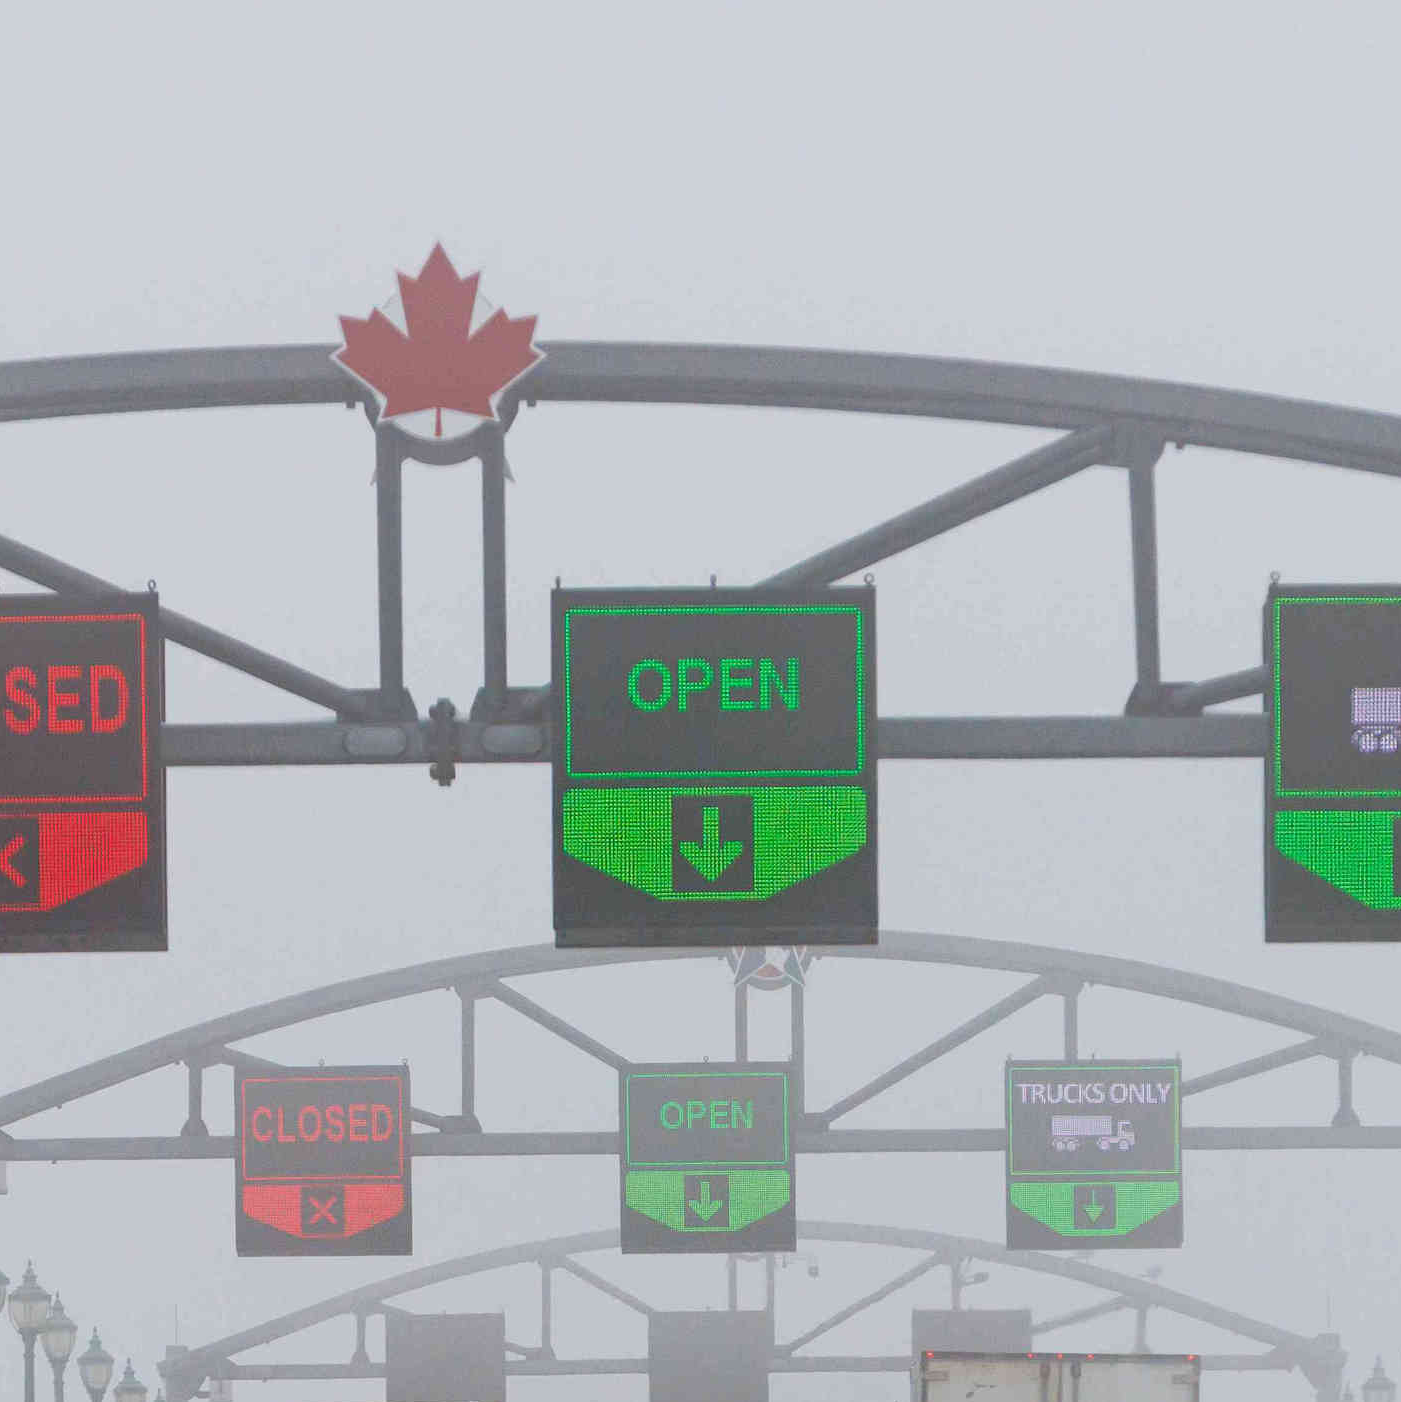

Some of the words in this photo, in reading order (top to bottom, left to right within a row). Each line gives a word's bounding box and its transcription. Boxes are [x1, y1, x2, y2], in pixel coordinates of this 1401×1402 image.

[626, 657, 801, 713] OPEN
[1015, 1082, 1104, 1105] TRUCKS
[1109, 1081, 1172, 1105] ONLY
[251, 1103, 394, 1144] CLOSED
[659, 1099, 754, 1131] OPEN
